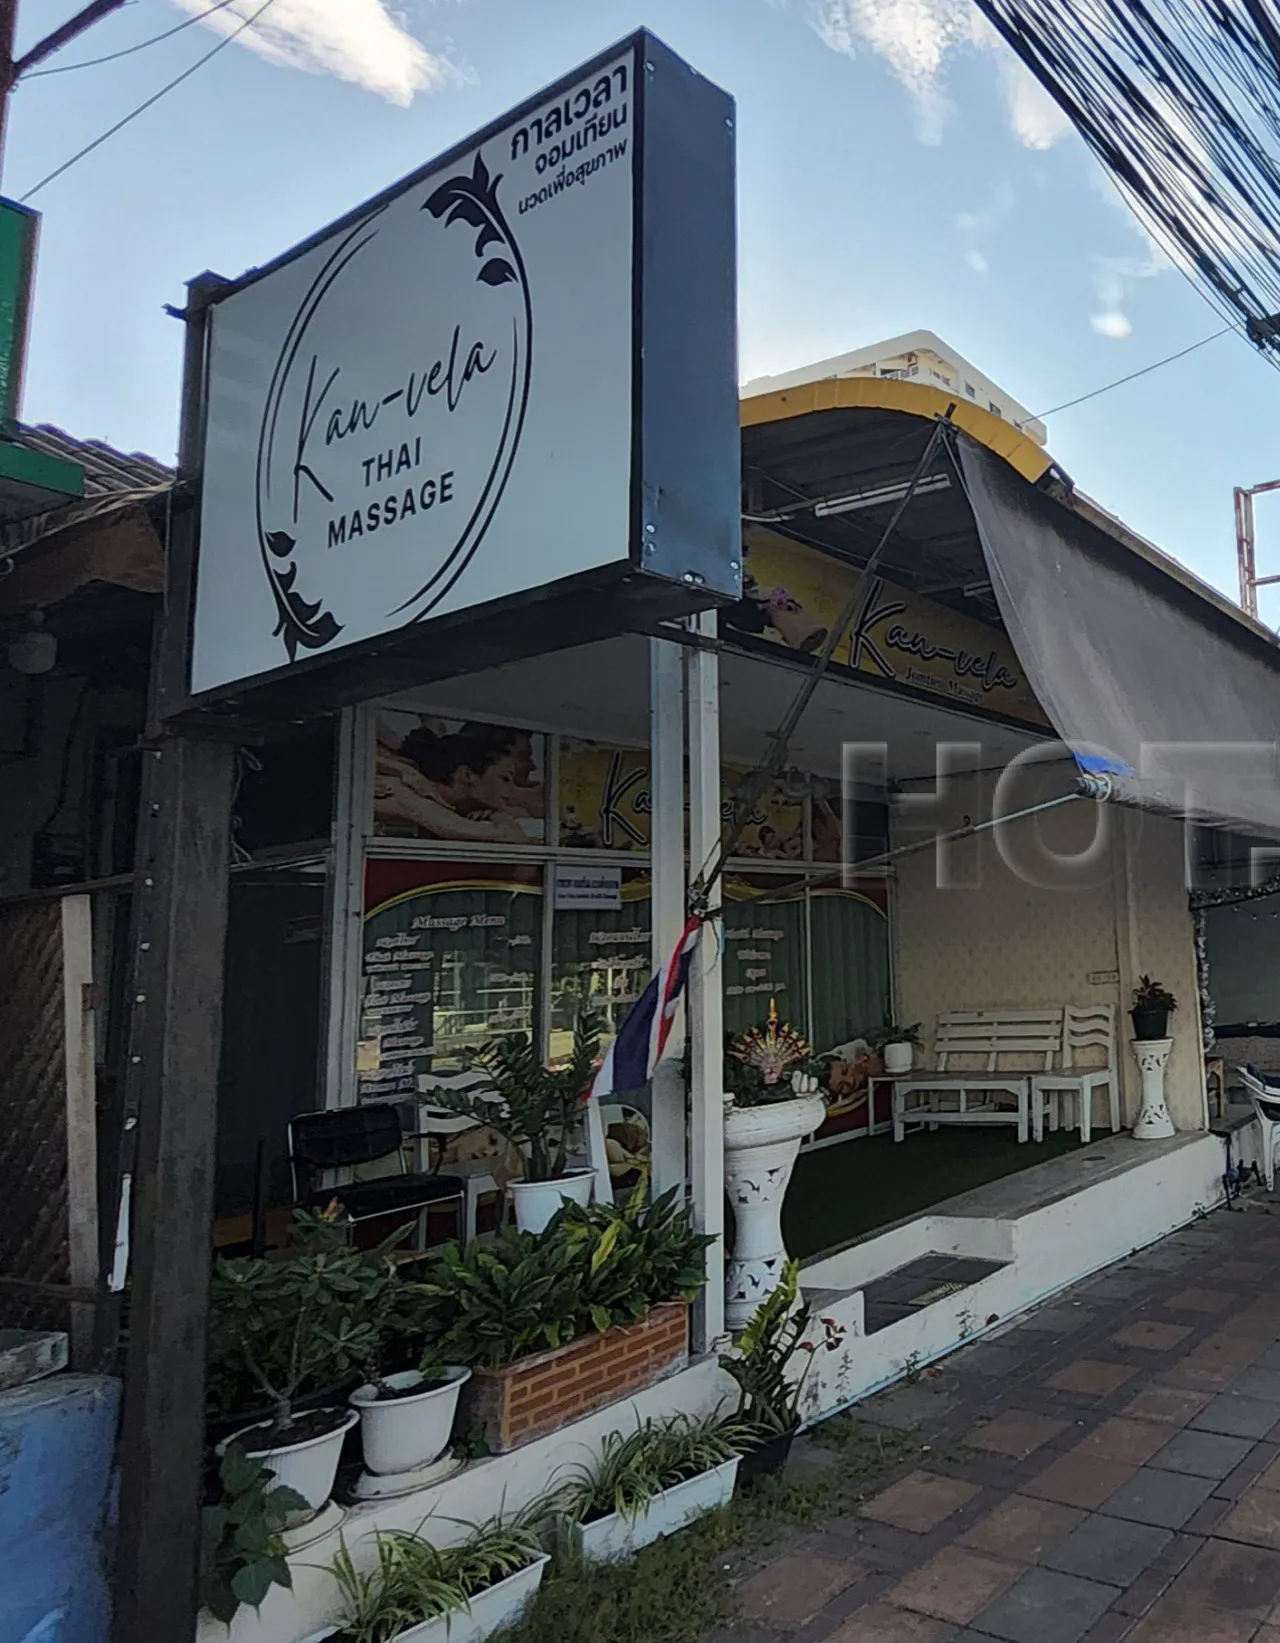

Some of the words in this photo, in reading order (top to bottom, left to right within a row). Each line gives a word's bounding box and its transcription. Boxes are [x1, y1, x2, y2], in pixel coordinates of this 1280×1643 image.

[511, 65, 627, 160] กาลเวลา
[535, 103, 627, 175] จอมเทียน
[518, 138, 627, 214] นวดเพื่อสุขภาพ
[292, 324, 497, 523] Kan-vela
[361, 436, 422, 488] THAI
[327, 471, 455, 548] MASSAGE
[850, 575, 1016, 691] Kan-vela
